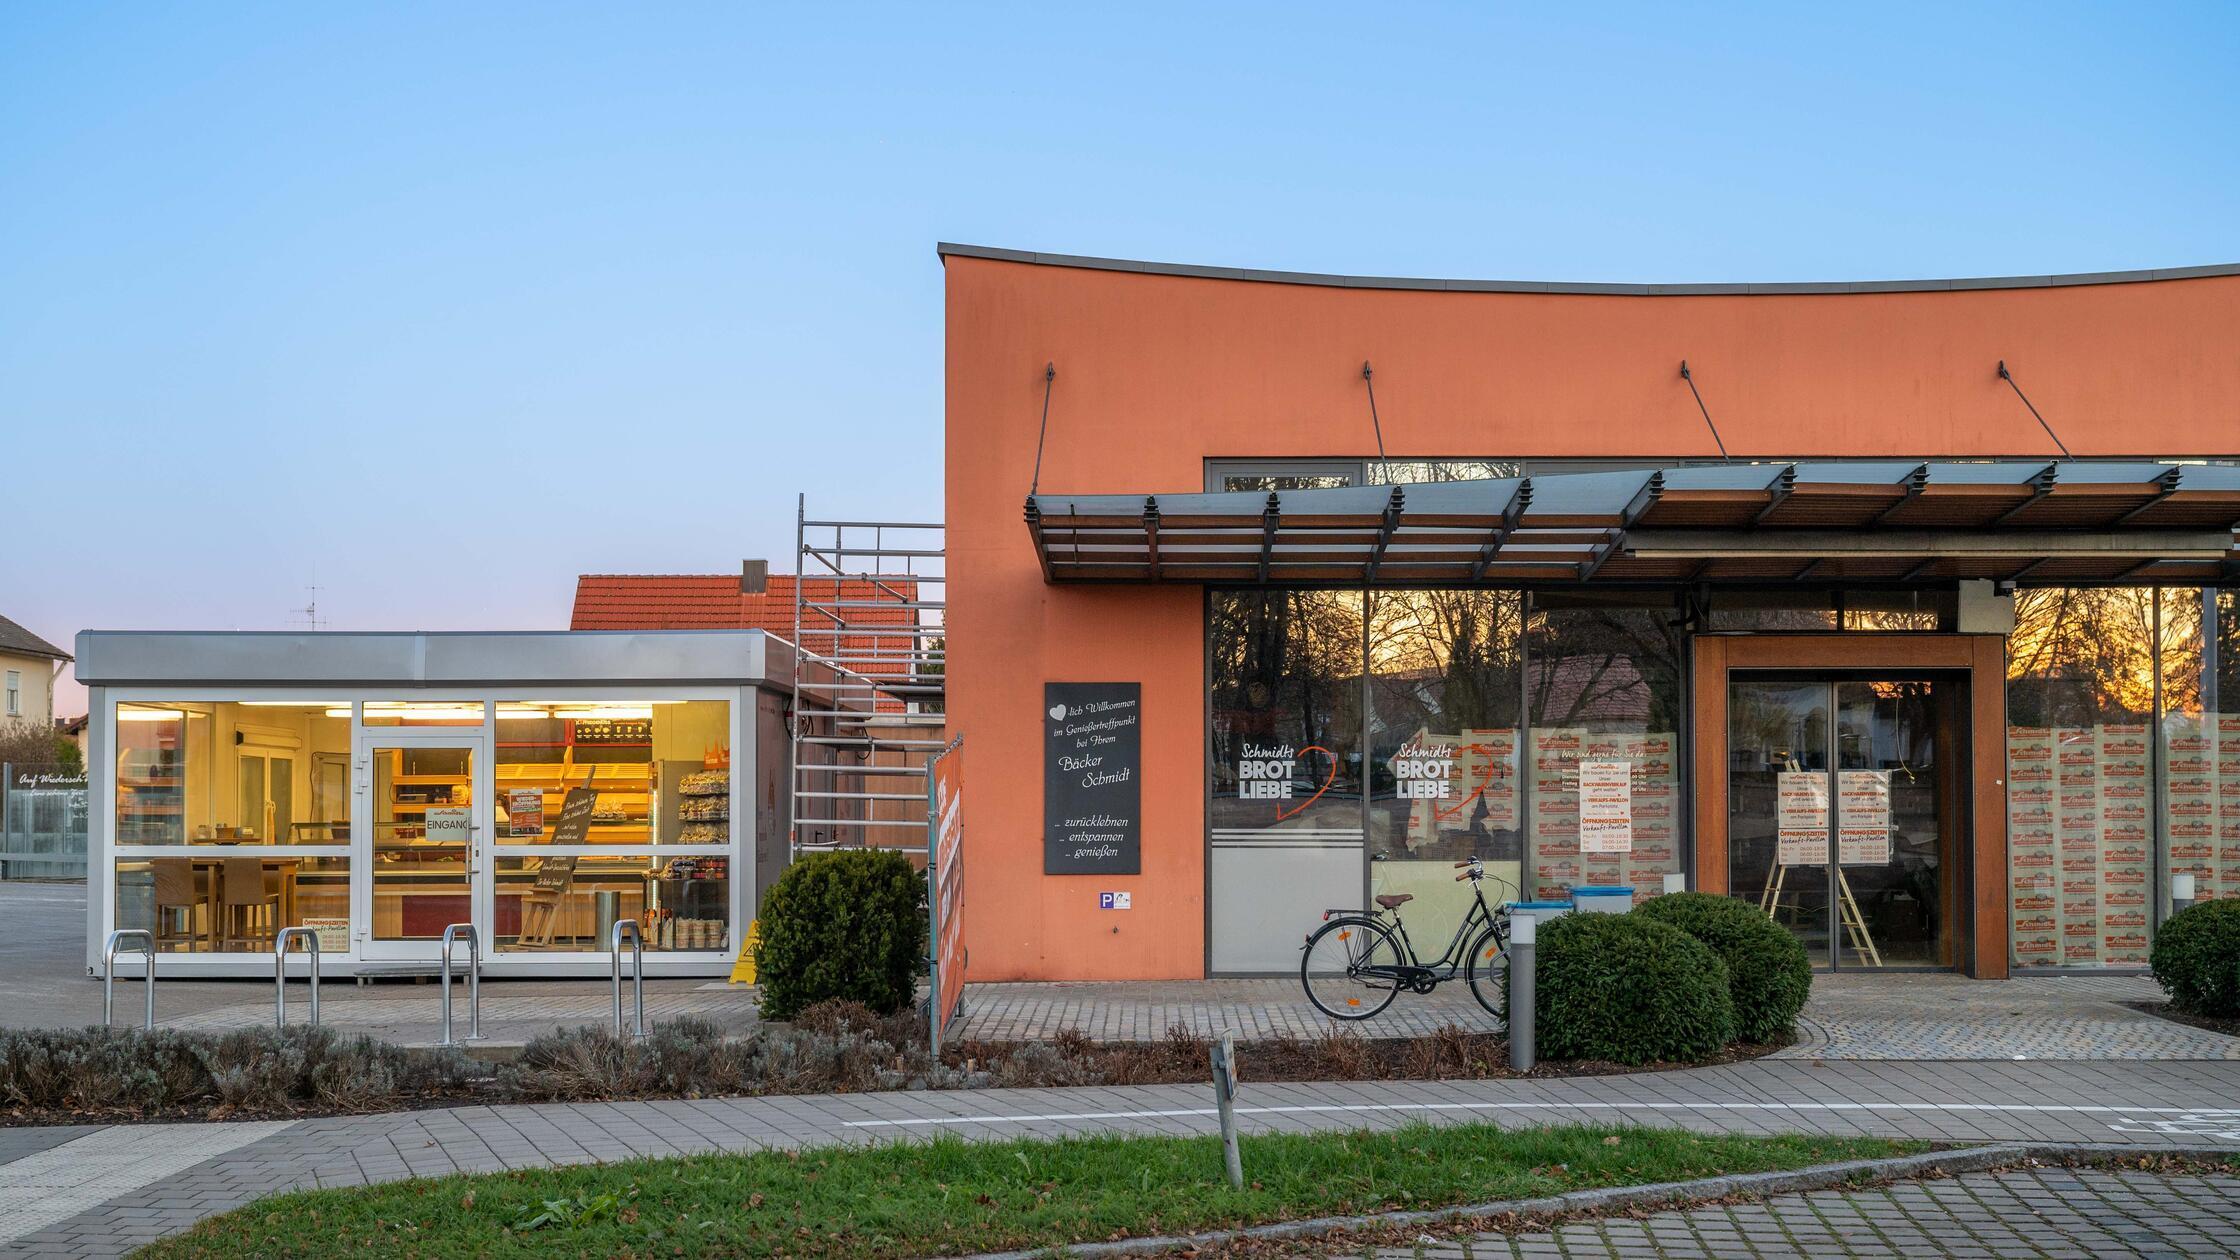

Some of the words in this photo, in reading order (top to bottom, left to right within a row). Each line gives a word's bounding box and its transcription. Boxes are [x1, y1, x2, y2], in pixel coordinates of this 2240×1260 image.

[1086, 700, 1136, 713] Willkommen
[1054, 728, 1063, 738] im
[1066, 715, 1136, 737] Genießertreffpunkt
[1076, 738, 1088, 749] bei
[1090, 735, 1116, 746] Ihrem
[1241, 743, 1293, 759] Schmidts
[1400, 743, 1452, 759] Schmidts
[1058, 755, 1103, 771] Bäcker
[1239, 760, 1296, 779] BROT
[1396, 760, 1453, 779] BROT
[20, 774, 38, 788] Auf
[1082, 768, 1130, 788] Schmidt
[1239, 780, 1291, 799] LIEBE
[1396, 780, 1449, 799] LIEBE
[1065, 815, 1129, 828] zurücklehnen
[1583, 824, 1628, 832] Verkaufs-Pavillon
[1069, 832, 1124, 845] entspannen
[1074, 844, 1118, 861] genießen
[1103, 894, 1112, 907] P
